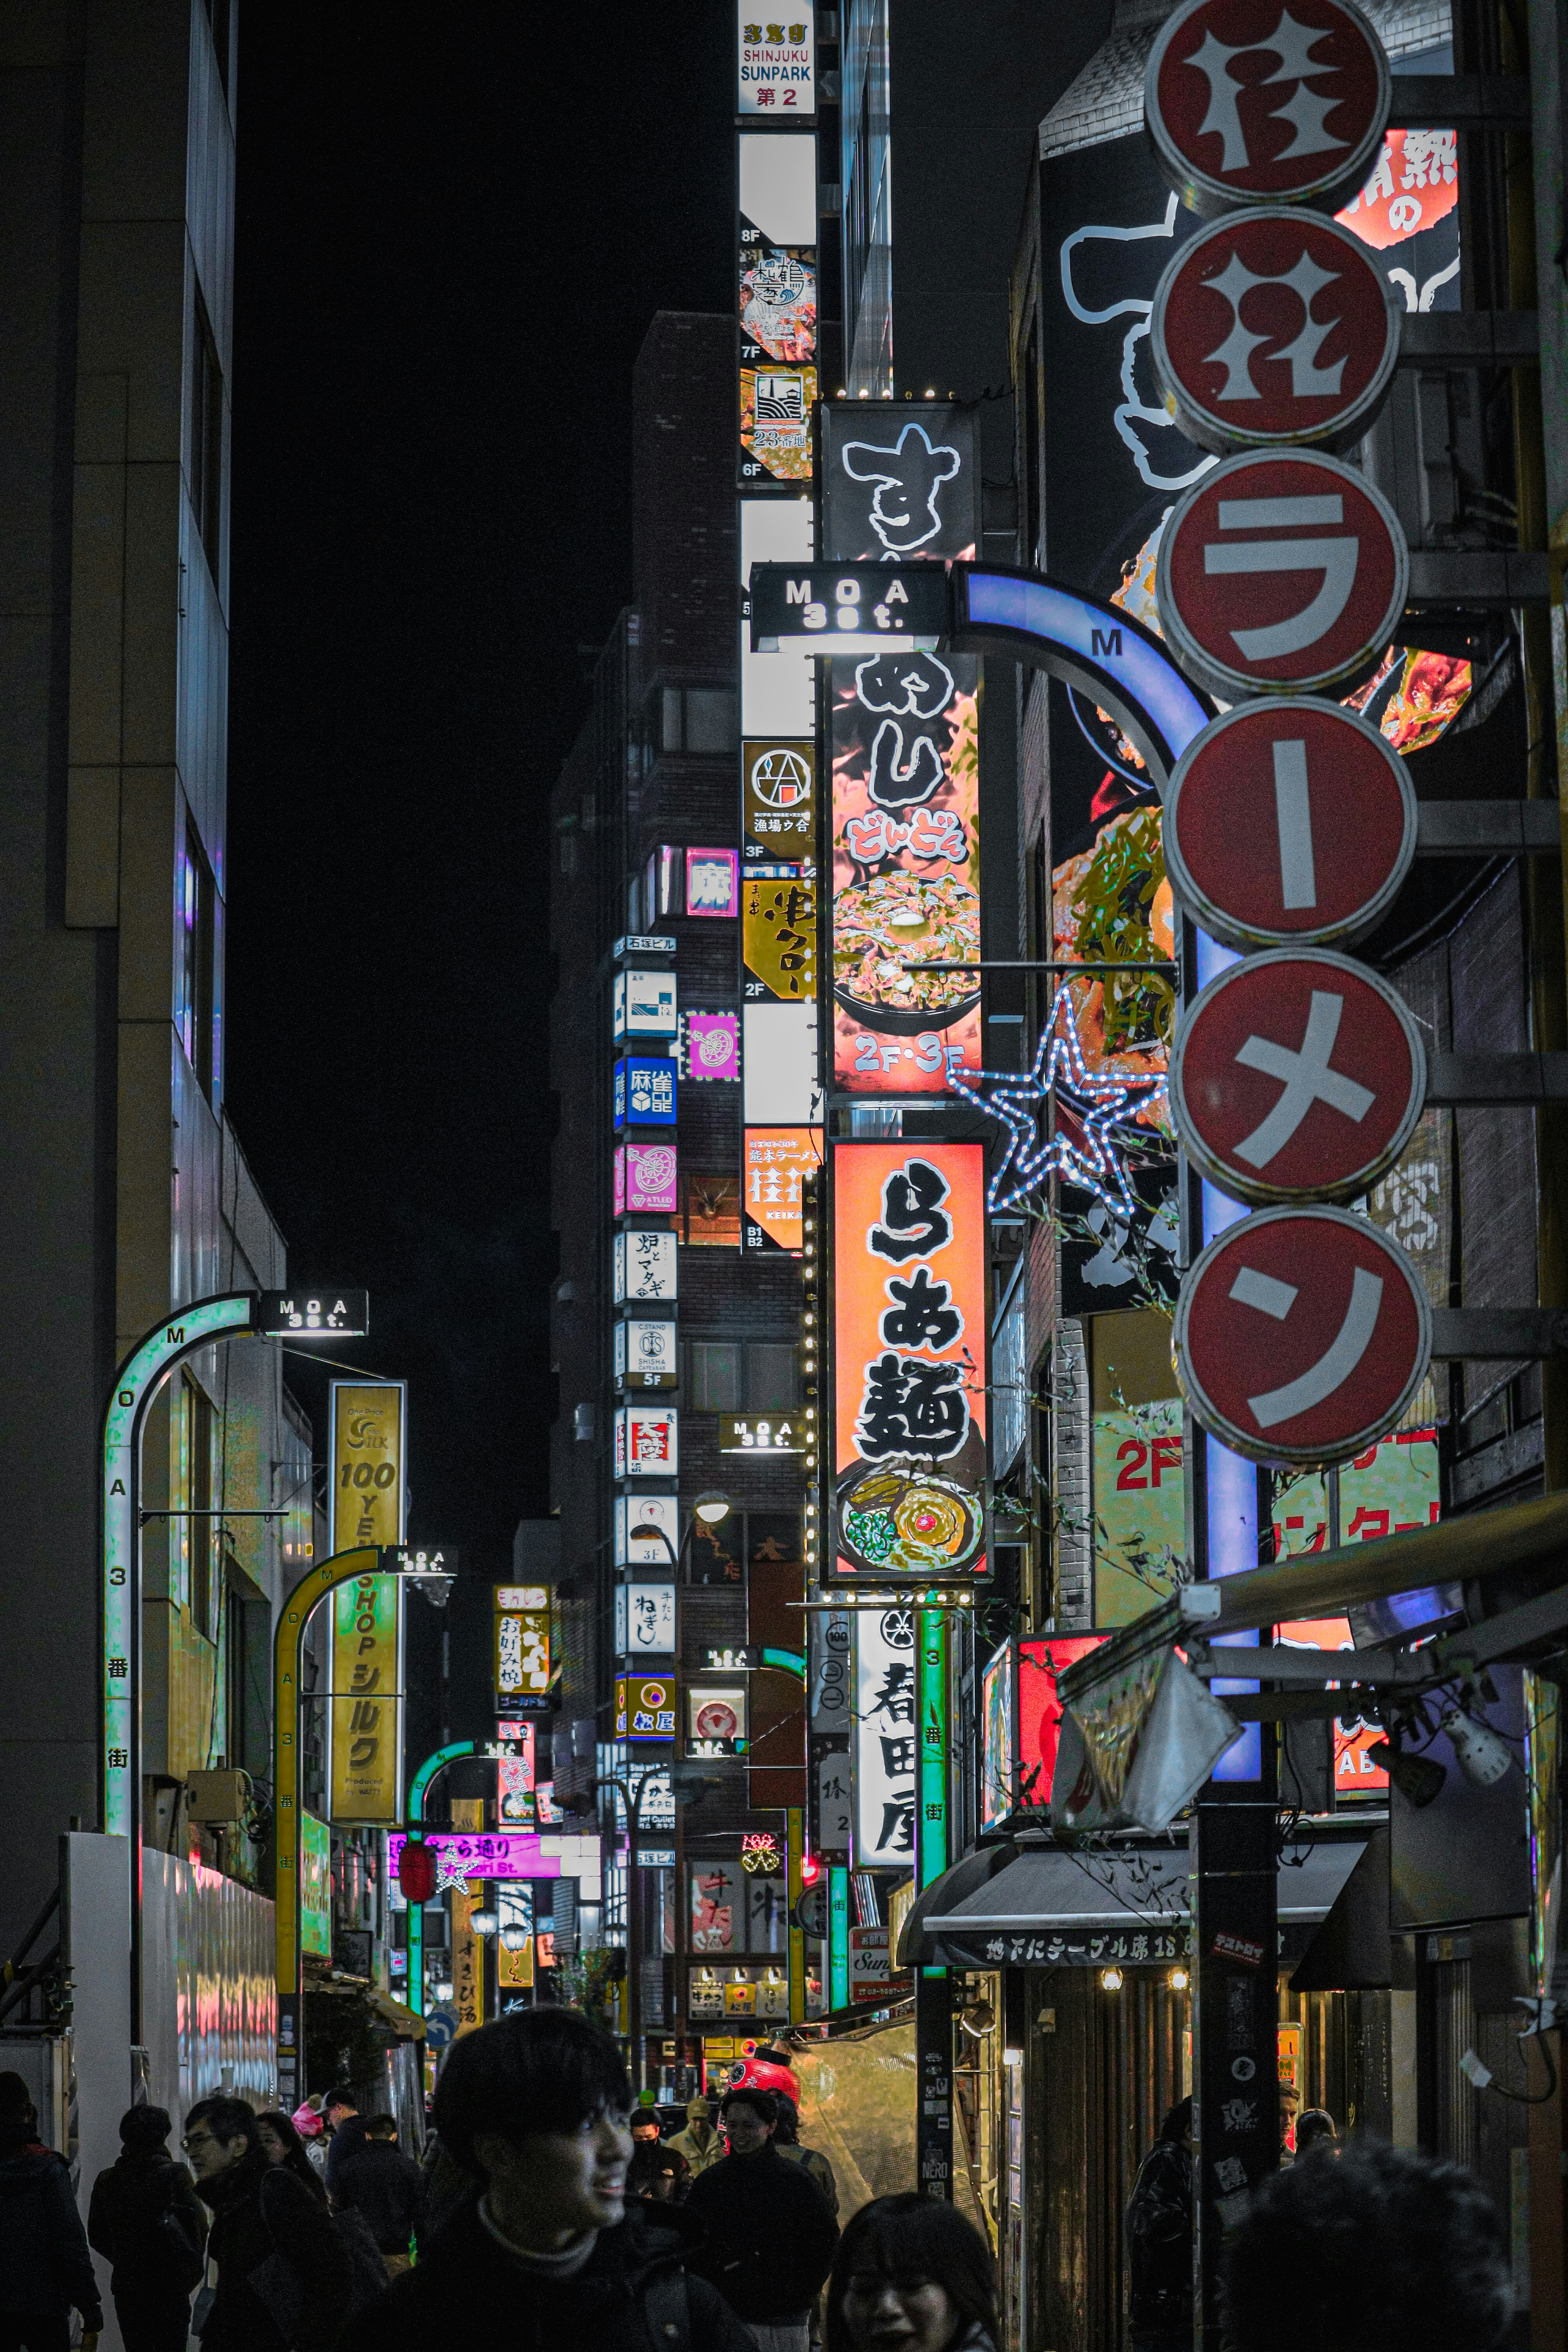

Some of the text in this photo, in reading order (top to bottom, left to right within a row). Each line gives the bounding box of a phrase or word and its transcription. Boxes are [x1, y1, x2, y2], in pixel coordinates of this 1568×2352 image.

[744, 50, 809, 62] SHINJUKU
[741, 65, 811, 81] SUNPARK
[757, 88, 797, 106] 第2
[1389, 194, 1422, 232] の
[742, 230, 760, 243] 8F
[741, 345, 760, 358] 7F
[753, 430, 806, 448] 23番地
[743, 463, 762, 476] 6F
[786, 579, 909, 604] MOA
[1091, 629, 1123, 656] M
[848, 808, 967, 864] どんどん
[745, 846, 764, 858] 3F
[629, 937, 675, 949] 石塚ビル
[745, 983, 765, 996] 2F
[631, 1070, 672, 1092] 麻雀
[749, 1149, 820, 1163] 熊本ラーメン
[767, 1211, 803, 1220] KEIKA
[747, 1227, 762, 1236] B1
[747, 1237, 763, 1247] B2
[636, 1234, 666, 1297] 炉とマタギ
[280, 1300, 347, 1314] MOA
[643, 1373, 661, 1386] 5F
[734, 1422, 792, 1434] MOA
[1116, 1436, 1183, 1491] 2F
[340, 1462, 396, 1489] 100
[398, 1552, 444, 1562] MOA
[644, 1549, 660, 1560] 3F
[661, 1591, 672, 1622] 牛たん
[635, 1595, 657, 1645] ねぎし
[500, 1619, 521, 1684] お好み焼
[633, 1711, 674, 1731] 松屋
[822, 1780, 850, 1800] 椿
[854, 1952, 890, 1970] Sun
